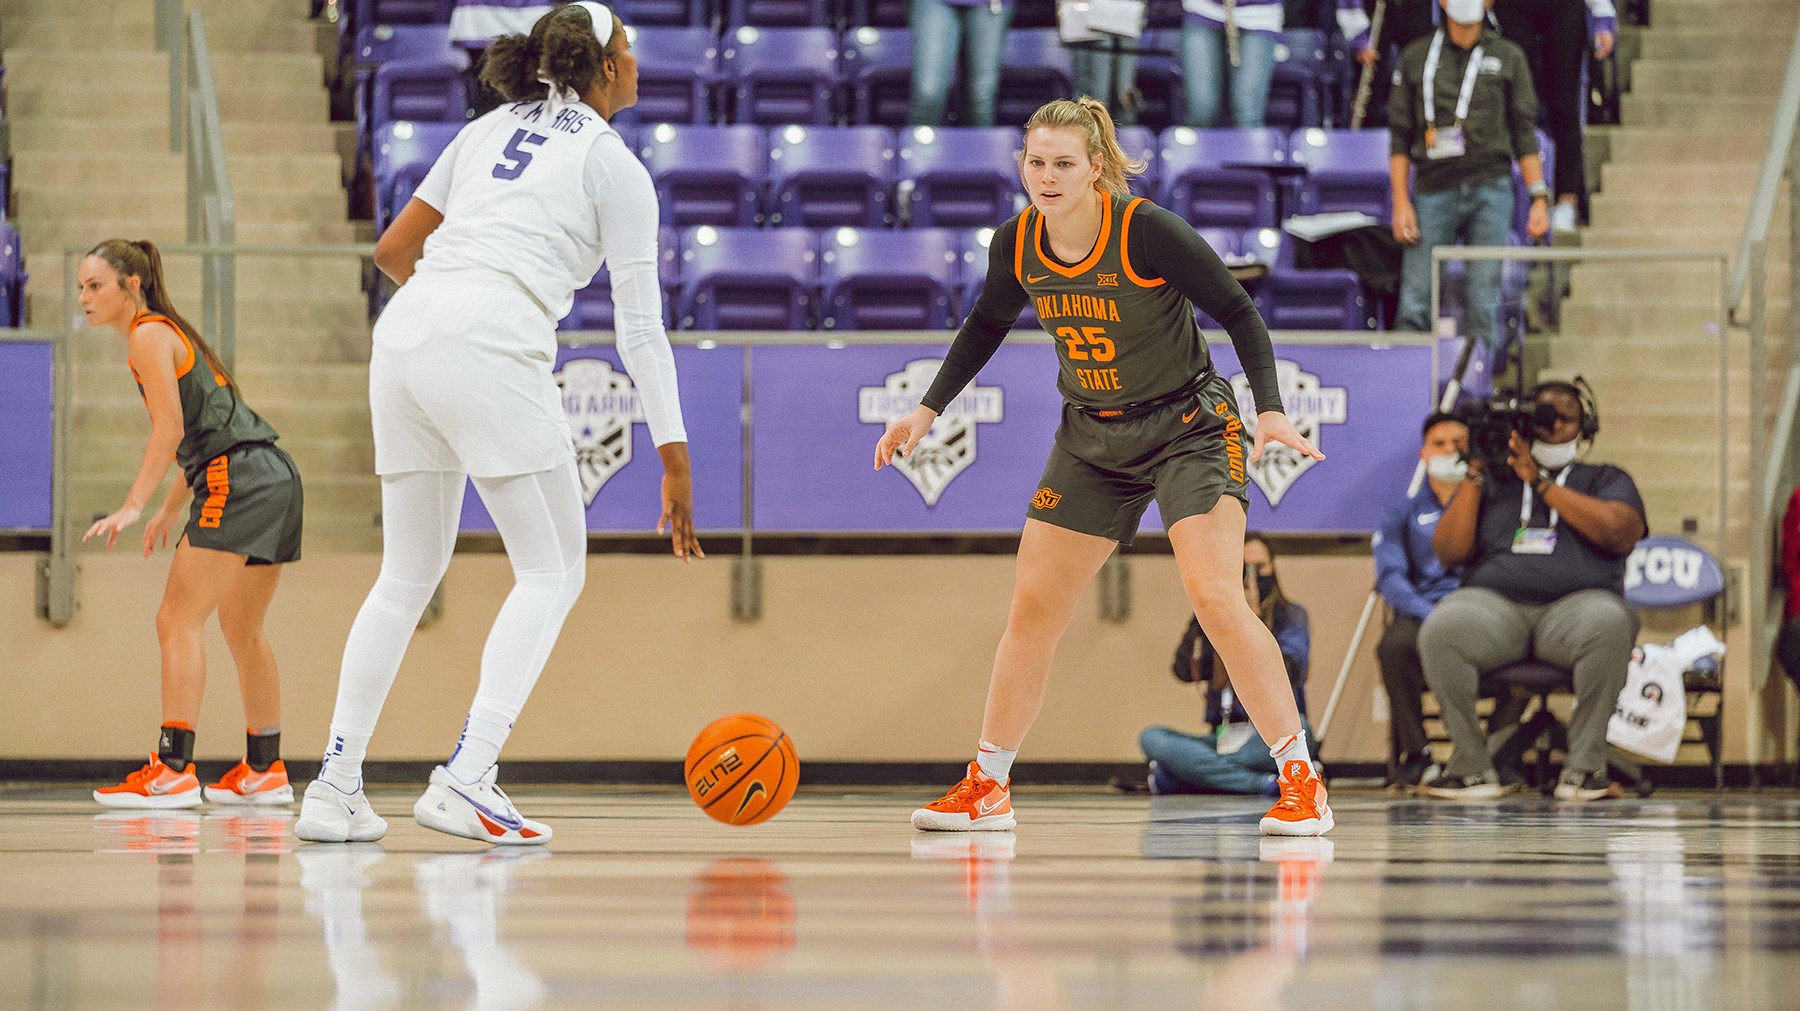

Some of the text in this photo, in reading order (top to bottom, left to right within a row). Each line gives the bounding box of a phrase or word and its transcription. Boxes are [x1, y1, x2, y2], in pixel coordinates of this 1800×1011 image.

[523, 102, 592, 134] MRRIS
[491, 128, 549, 180] 5
[1036, 293, 1121, 323] OKLAHOMA
[1055, 326, 1116, 362] 25
[1075, 368, 1122, 391] STATE
[695, 753, 743, 798] ELITE
